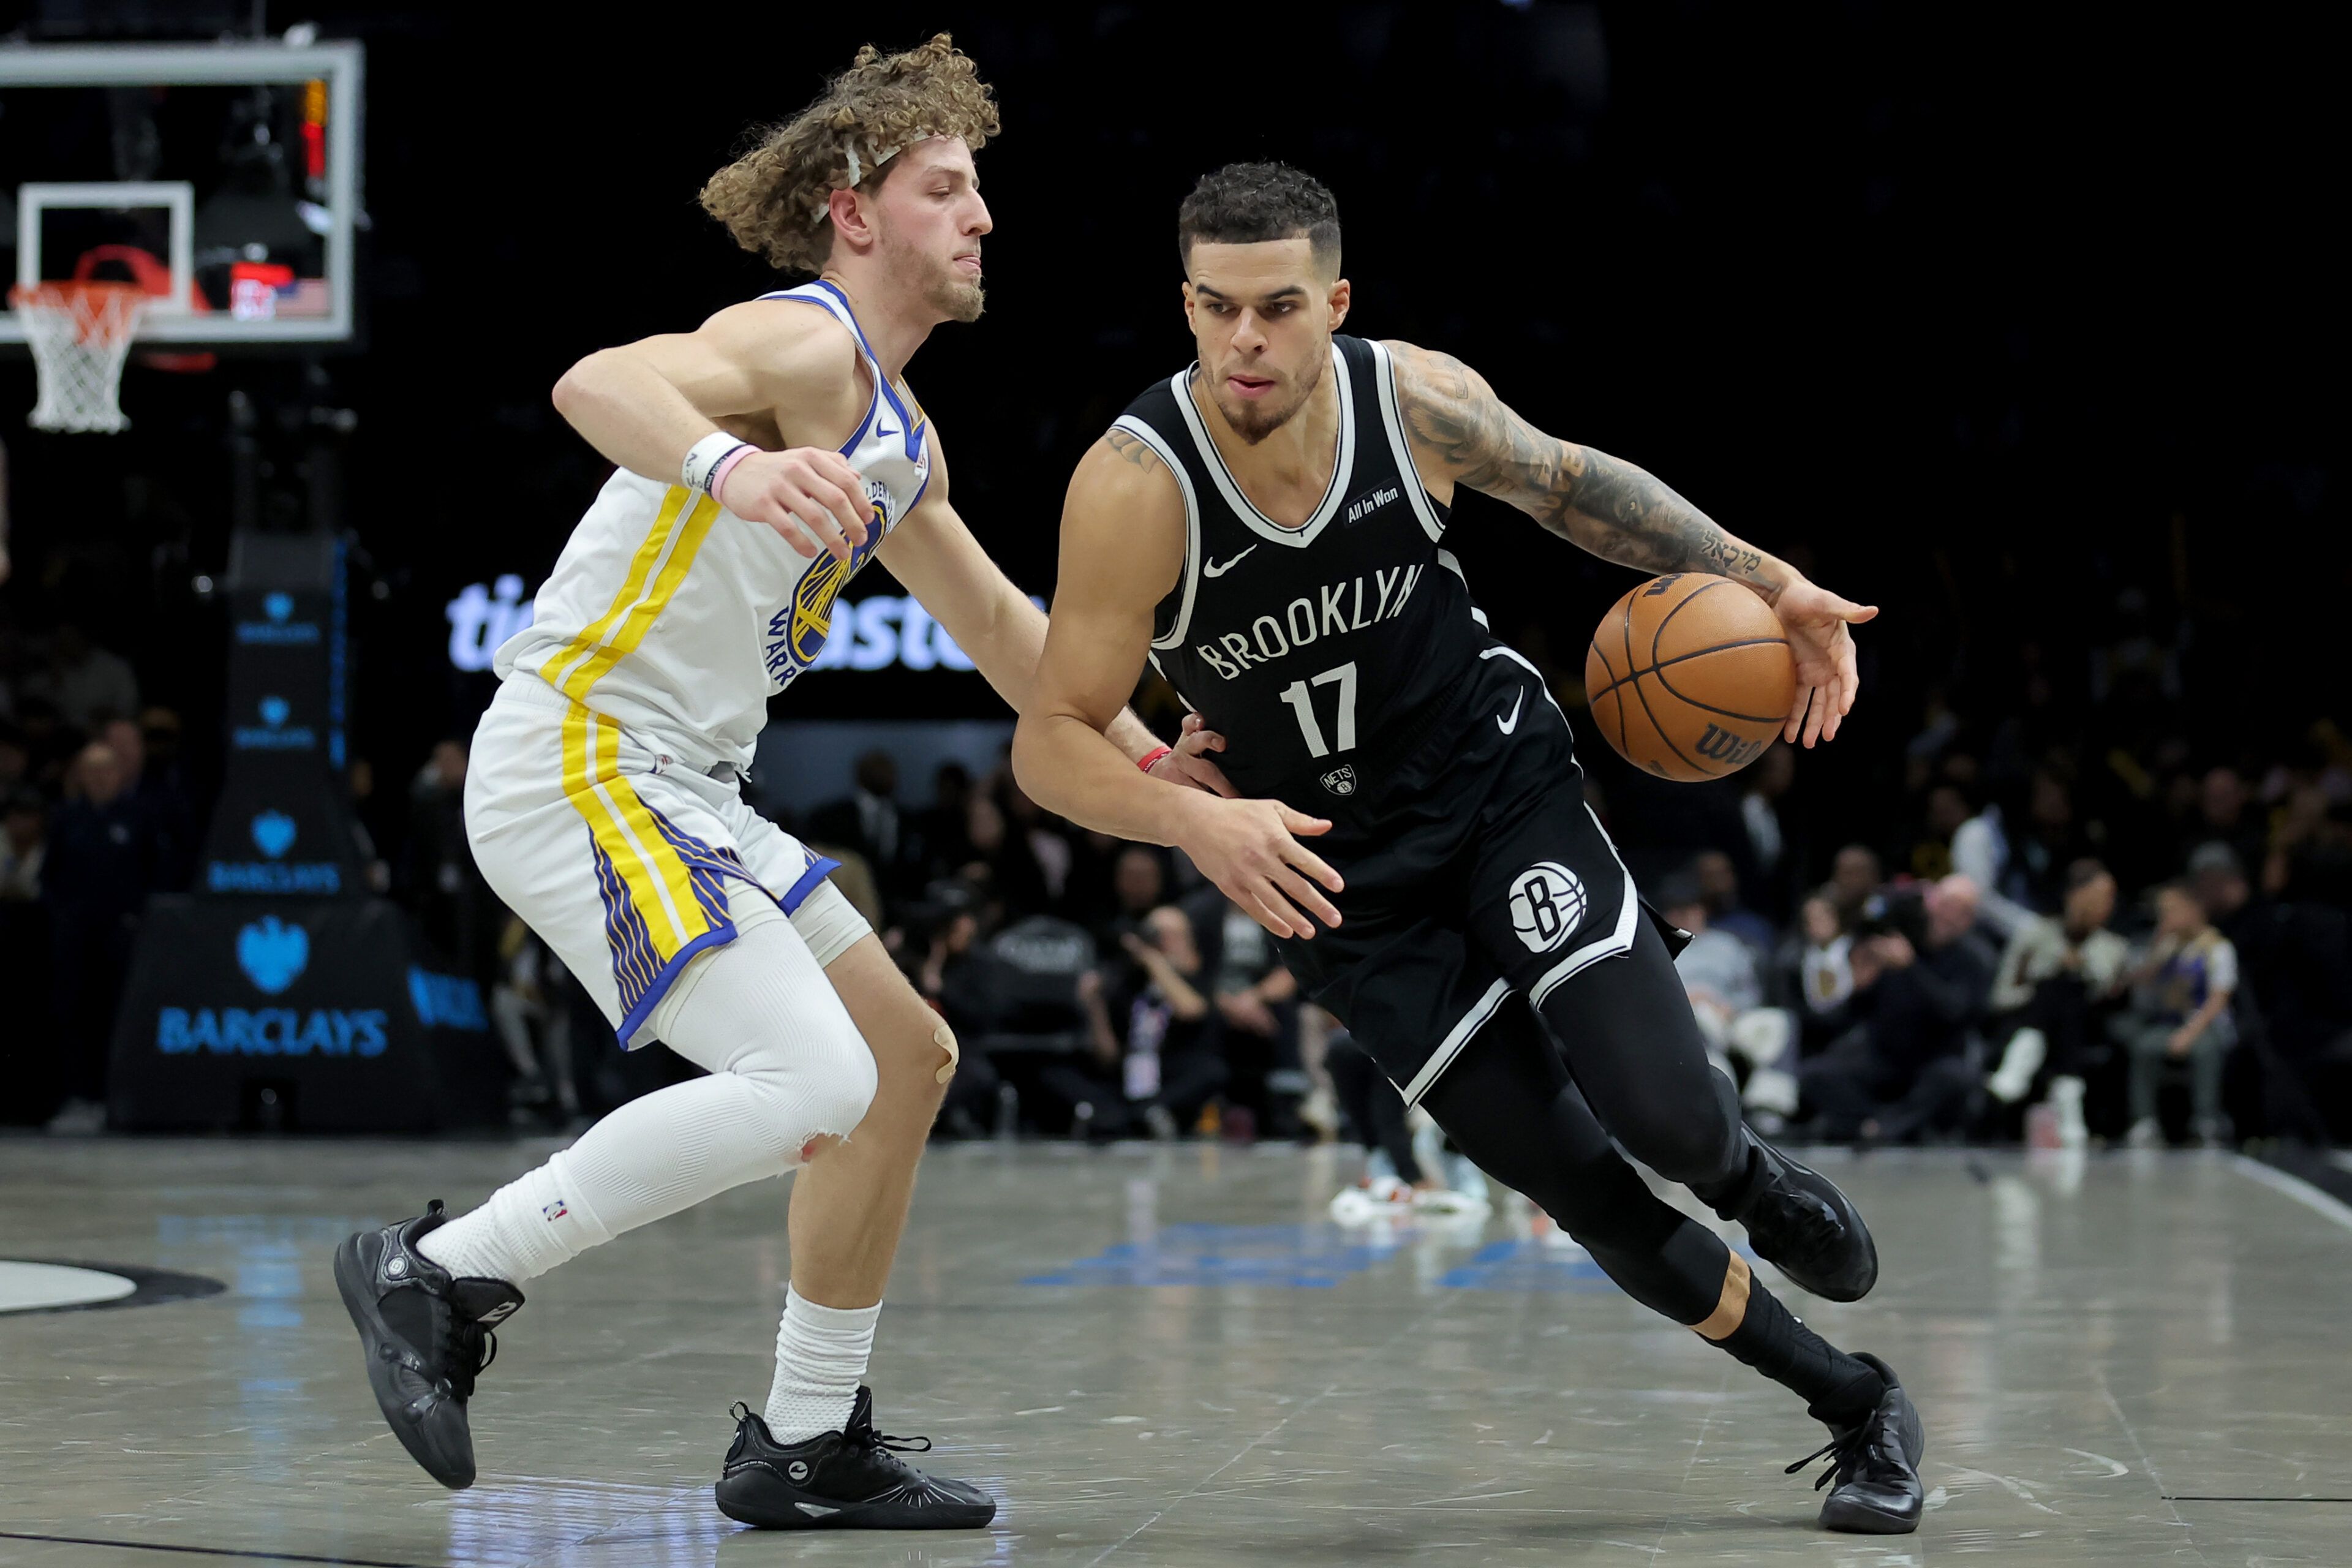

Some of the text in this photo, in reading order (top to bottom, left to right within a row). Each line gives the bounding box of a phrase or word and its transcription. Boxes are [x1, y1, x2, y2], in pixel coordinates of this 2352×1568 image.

[1349, 488, 1398, 523] All In Won
[766, 605, 797, 687] WARR
[1197, 564, 1424, 680] BROOKLYN
[1280, 661, 1357, 758] 17
[1695, 722, 1762, 764] Wil
[1324, 767, 1352, 788] NETS
[157, 1008, 387, 1057] BARCLAYS
